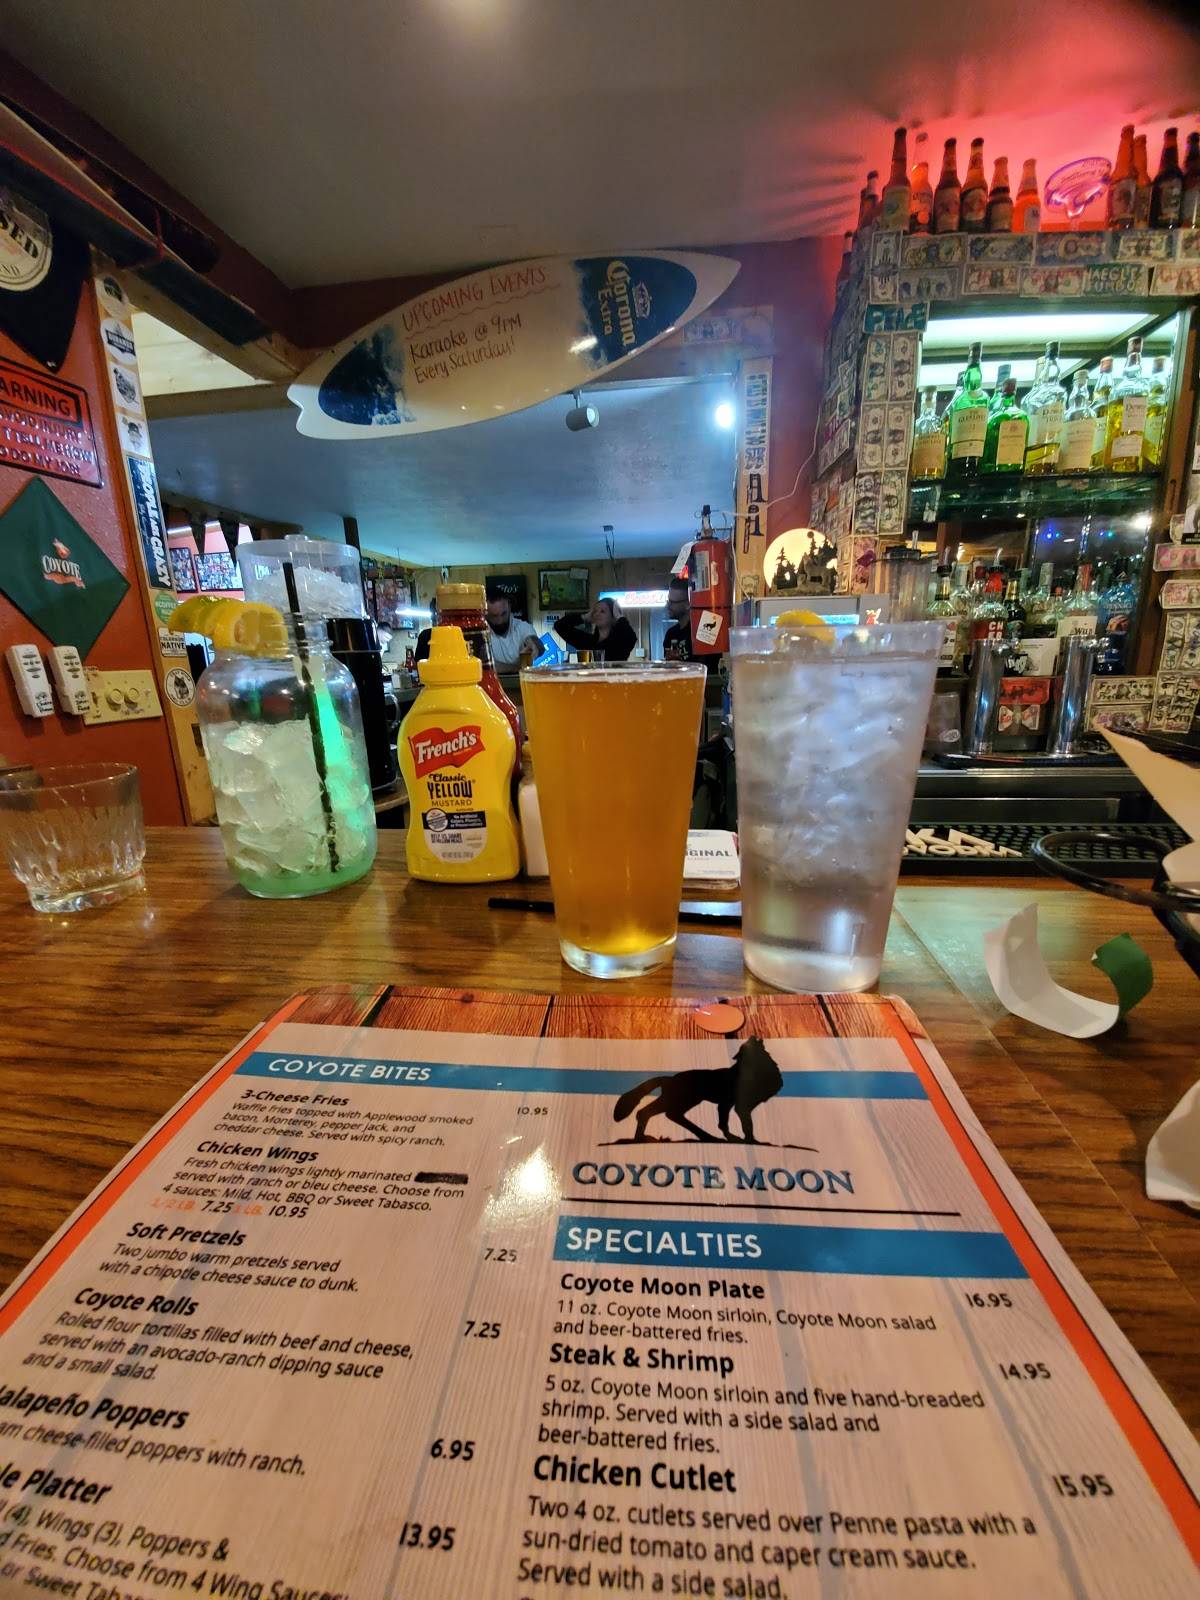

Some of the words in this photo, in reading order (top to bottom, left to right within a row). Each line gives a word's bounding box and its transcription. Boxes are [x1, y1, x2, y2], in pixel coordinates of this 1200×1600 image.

[401, 282, 483, 332] UPCOMING
[598, 287, 613, 335] Extra
[607, 260, 636, 346] Corona
[410, 330, 468, 364] Karaoke
[414, 364, 450, 384] Every
[0, 377, 71, 417] ARNING
[42, 555, 82, 580] COYOTE
[150, 536, 171, 587] CRAZY
[161, 641, 186, 650] NATIVE
[416, 731, 477, 764] French's
[427, 780, 472, 799] YELLOW
[429, 773, 465, 782] Classic
[431, 799, 472, 807] MUSTARD
[268, 1059, 366, 1077] COYOTE
[370, 1065, 431, 1081] BITES
[241, 1089, 310, 1105] 3-Cheese
[311, 1094, 350, 1106] Fries
[517, 1106, 548, 1116] 10.95
[232, 1102, 265, 1113] Waffle
[268, 1105, 293, 1115] fries
[295, 1107, 336, 1119] topped
[337, 1110, 362, 1119] with
[363, 1112, 426, 1124] Applewood
[429, 1115, 473, 1125] smoked
[196, 1140, 263, 1158] Chicken
[266, 1146, 319, 1164] Wings
[184, 1157, 219, 1169] Fresh
[219, 1159, 266, 1174] chicken
[268, 1165, 304, 1178] wings
[306, 1166, 345, 1180] lightly
[347, 1170, 412, 1182] marinated
[572, 1161, 726, 1189] COYOTE
[734, 1166, 856, 1195] MOON
[201, 1201, 235, 1214] 7.25
[268, 1206, 309, 1219] 10.95
[126, 1222, 169, 1240] Soft
[168, 1227, 247, 1247] Pretzels
[566, 1227, 762, 1259] SPECIALTIES
[113, 1243, 142, 1257] Two
[138, 1246, 188, 1262] jumbo
[190, 1253, 230, 1265] warm
[231, 1254, 288, 1269] pretzels
[291, 1259, 341, 1273] served
[483, 1248, 518, 1263] 7.25
[99, 1261, 130, 1275] with
[131, 1264, 143, 1275] a
[143, 1264, 200, 1281] chipotle
[201, 1270, 252, 1285] cheese
[254, 1274, 297, 1288] sauce
[299, 1277, 316, 1289] to
[318, 1276, 359, 1292] dunk.
[561, 1273, 634, 1296] Coyote
[641, 1277, 701, 1297] Moon
[708, 1280, 765, 1299] Plate
[74, 1288, 146, 1312] Coyote
[146, 1296, 200, 1316] Rolls
[558, 1300, 574, 1314] 11
[580, 1303, 601, 1316] oz.
[607, 1302, 662, 1320] Coyote
[666, 1305, 713, 1320] Moon
[717, 1308, 772, 1326] sirloin,
[776, 1309, 834, 1329] Coyote
[838, 1314, 888, 1330] Moon
[891, 1315, 937, 1331] salad
[965, 1292, 1013, 1309] 16.95
[56, 1311, 103, 1331] Rolled
[103, 1316, 141, 1333] flour
[142, 1322, 200, 1340] tortillas
[201, 1326, 243, 1344] filled
[243, 1330, 278, 1347] with
[279, 1333, 320, 1350] beef
[319, 1338, 353, 1354] and
[354, 1339, 414, 1361] cheese,
[463, 1321, 502, 1339] 7.25
[553, 1320, 584, 1335] and
[589, 1321, 702, 1341] beer-battered
[706, 1326, 749, 1344] fries.
[39, 1332, 93, 1350] served
[93, 1338, 126, 1354] with
[127, 1342, 146, 1356] an
[149, 1345, 266, 1369] avocado-ranch
[269, 1353, 332, 1379] dipping
[334, 1361, 384, 1379] sauce
[549, 1343, 616, 1366] Steak
[623, 1347, 640, 1368] &
[647, 1348, 734, 1379] Shrimp
[999, 1362, 1052, 1381] 14.95
[545, 1375, 556, 1391] 5
[561, 1379, 585, 1394] oz.
[591, 1378, 651, 1400] Coyote
[657, 1382, 708, 1400] Moon
[713, 1385, 769, 1404] sirloin
[775, 1388, 809, 1405] and
[814, 1388, 847, 1407] five
[850, 1390, 985, 1408] hand-breaded
[90, 1398, 190, 1430] Poppers
[541, 1400, 610, 1423] shrimp.
[616, 1403, 678, 1424] Served
[683, 1408, 723, 1428] with
[729, 1413, 739, 1428] a
[745, 1412, 784, 1430] side
[789, 1413, 838, 1432] salad
[843, 1414, 880, 1432] and
[22, 1423, 130, 1455] cheese-filled
[126, 1440, 204, 1467] poppers
[207, 1447, 248, 1468] with
[250, 1453, 306, 1476] ranch.
[430, 1438, 476, 1463] 6.95
[537, 1423, 667, 1451] beer-battered
[673, 1433, 720, 1453] fries.
[22, 1468, 113, 1504] Platter
[533, 1454, 642, 1487] Chicken
[650, 1463, 737, 1492] Cutlet
[1052, 1474, 1115, 1498] 15.95
[528, 1495, 568, 1519] Two
[574, 1500, 587, 1520] 4
[593, 1505, 621, 1523] oz.
[627, 1504, 696, 1528] cutlets
[702, 1509, 771, 1532] served
[778, 1514, 822, 1533] over
[830, 1512, 898, 1536] Penne
[905, 1515, 964, 1540] pasta
[969, 1512, 1016, 1536] with
[1023, 1517, 1036, 1535] a
[399, 1522, 457, 1551] 13.95
[522, 1528, 623, 1555] sun-dried
[630, 1535, 707, 1560] tomato
[714, 1540, 754, 1563] and
[761, 1546, 821, 1571] caper
[828, 1548, 898, 1569] cream
[904, 1549, 976, 1570] sauce.
[517, 1557, 591, 1588] Served
[598, 1565, 645, 1591] with
[651, 1573, 664, 1593] a
[671, 1570, 716, 1595] side
[722, 1575, 788, 1600] salad.
